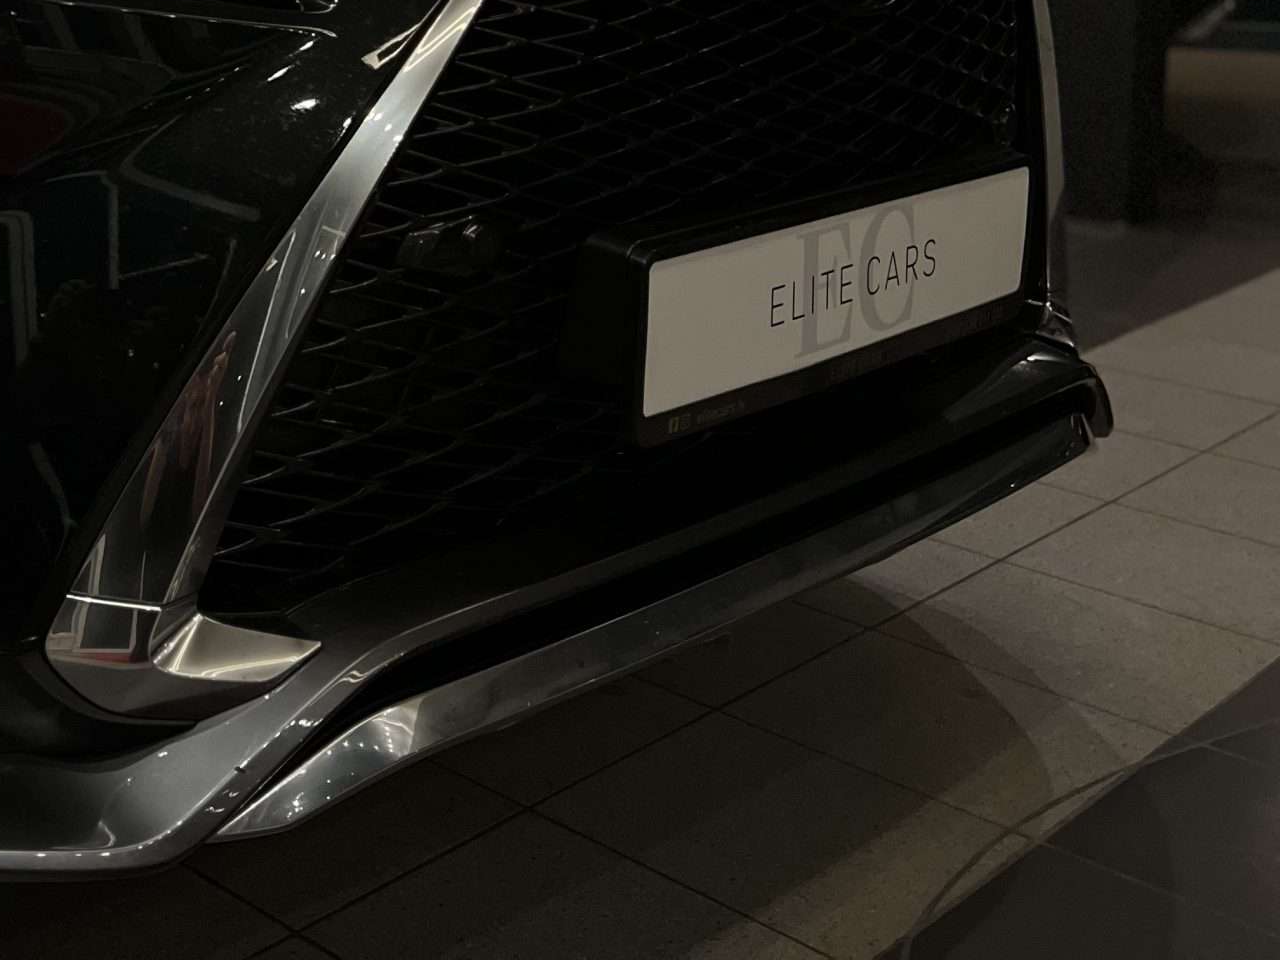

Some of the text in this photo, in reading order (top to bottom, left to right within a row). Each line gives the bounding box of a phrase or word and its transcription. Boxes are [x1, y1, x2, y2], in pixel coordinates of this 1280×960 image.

[770, 238, 936, 327] ELITE CARS
[794, 203, 916, 359] EC
